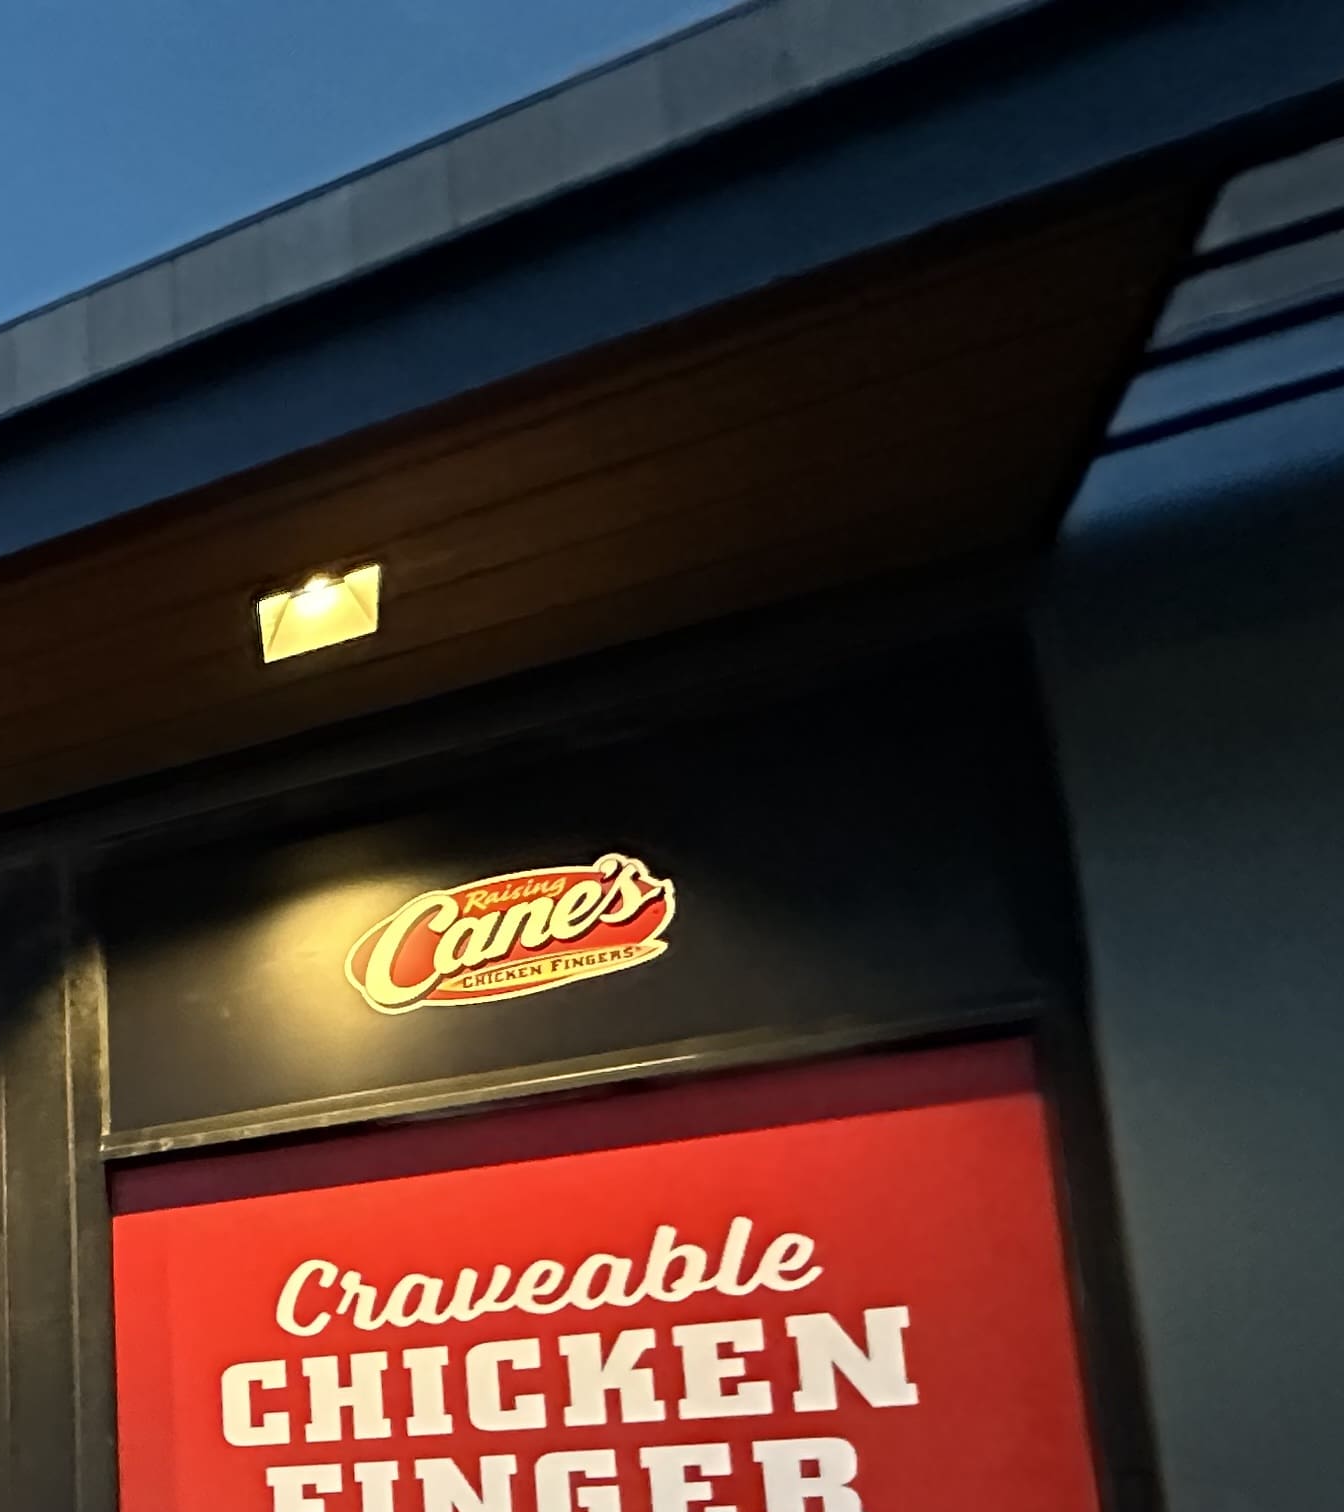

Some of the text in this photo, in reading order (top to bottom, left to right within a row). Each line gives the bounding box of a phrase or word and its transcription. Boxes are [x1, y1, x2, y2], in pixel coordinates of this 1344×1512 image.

[365, 857, 664, 1005] Cane's
[463, 877, 568, 914] Raising
[462, 947, 635, 989] CHICKEN FINGERS
[275, 1216, 823, 1337] Craveable
[220, 1306, 919, 1448] CHICKEN
